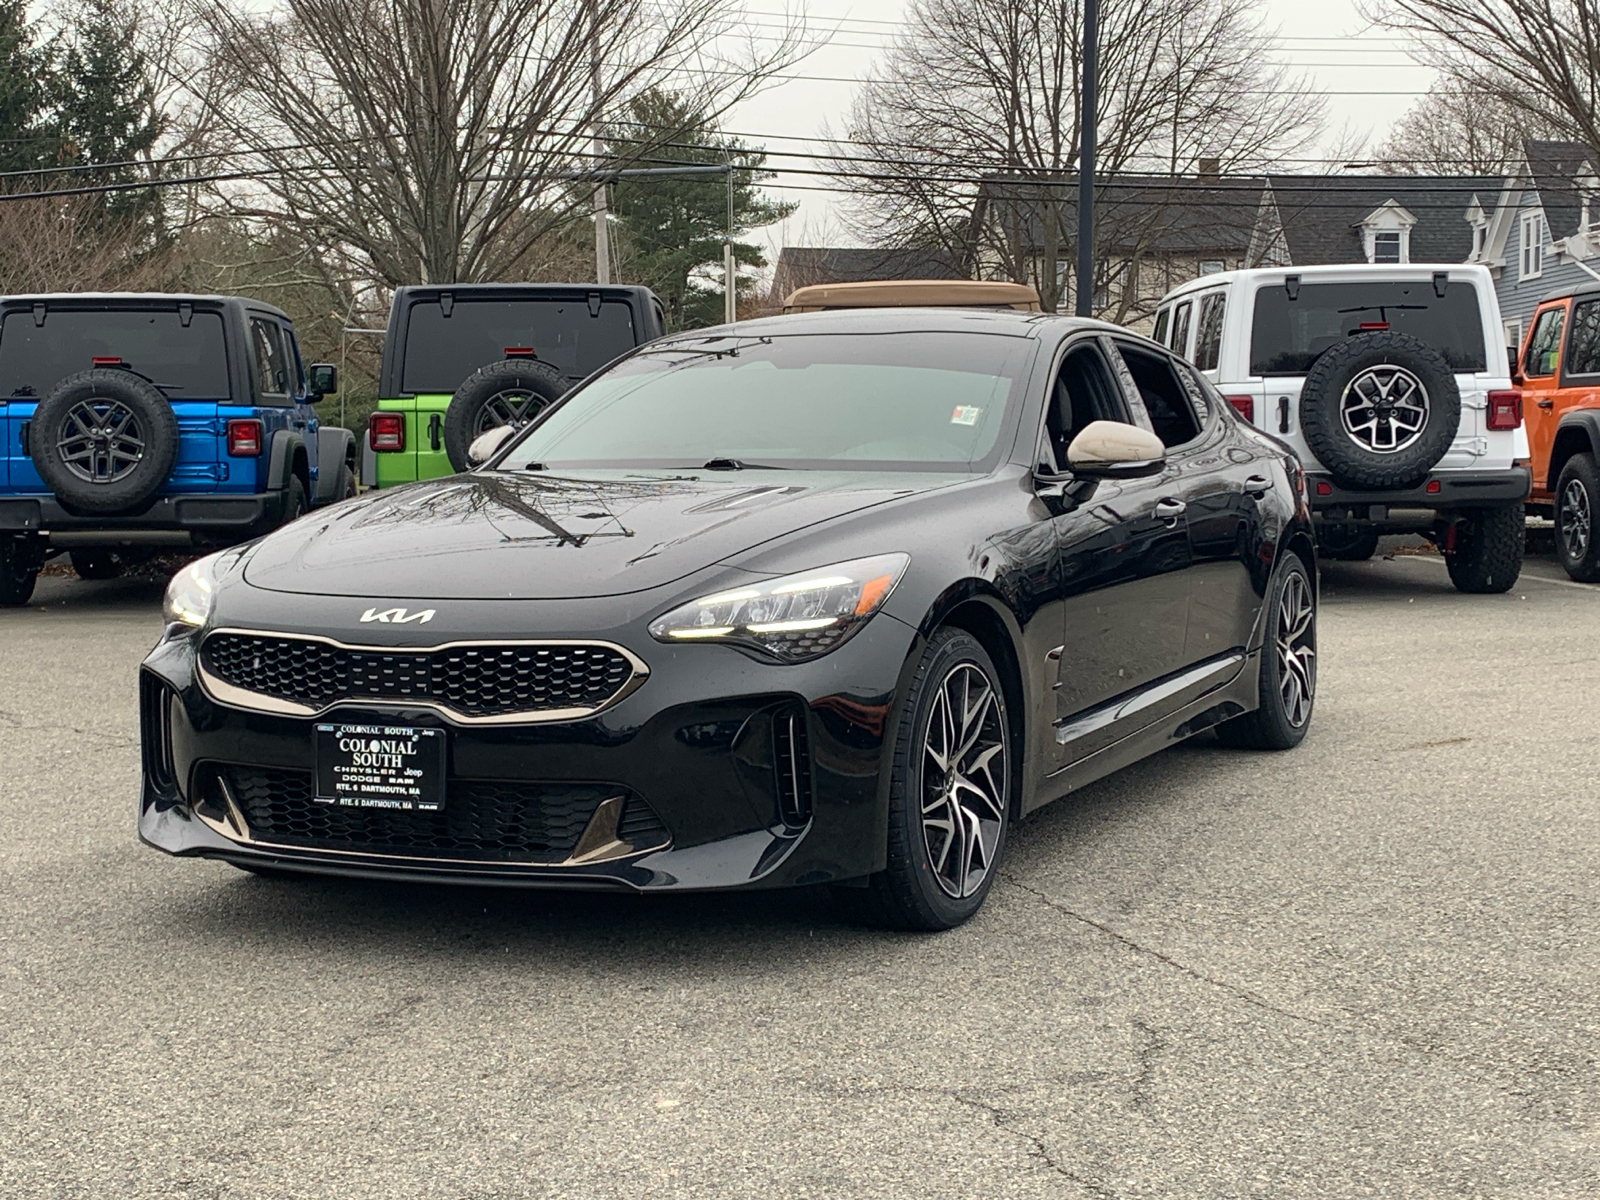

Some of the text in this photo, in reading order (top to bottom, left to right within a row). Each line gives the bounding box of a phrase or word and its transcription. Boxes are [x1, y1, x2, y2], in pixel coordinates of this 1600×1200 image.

[341, 726, 380, 734] COLONIAL
[384, 728, 413, 736] SOUTH
[340, 738, 417, 754] COLONIAL
[352, 753, 402, 767] SOUTH
[334, 766, 423, 777] CHRYSLER Jeep
[342, 774, 381, 783] DODGE
[361, 785, 408, 795] DARTMOUTH,
